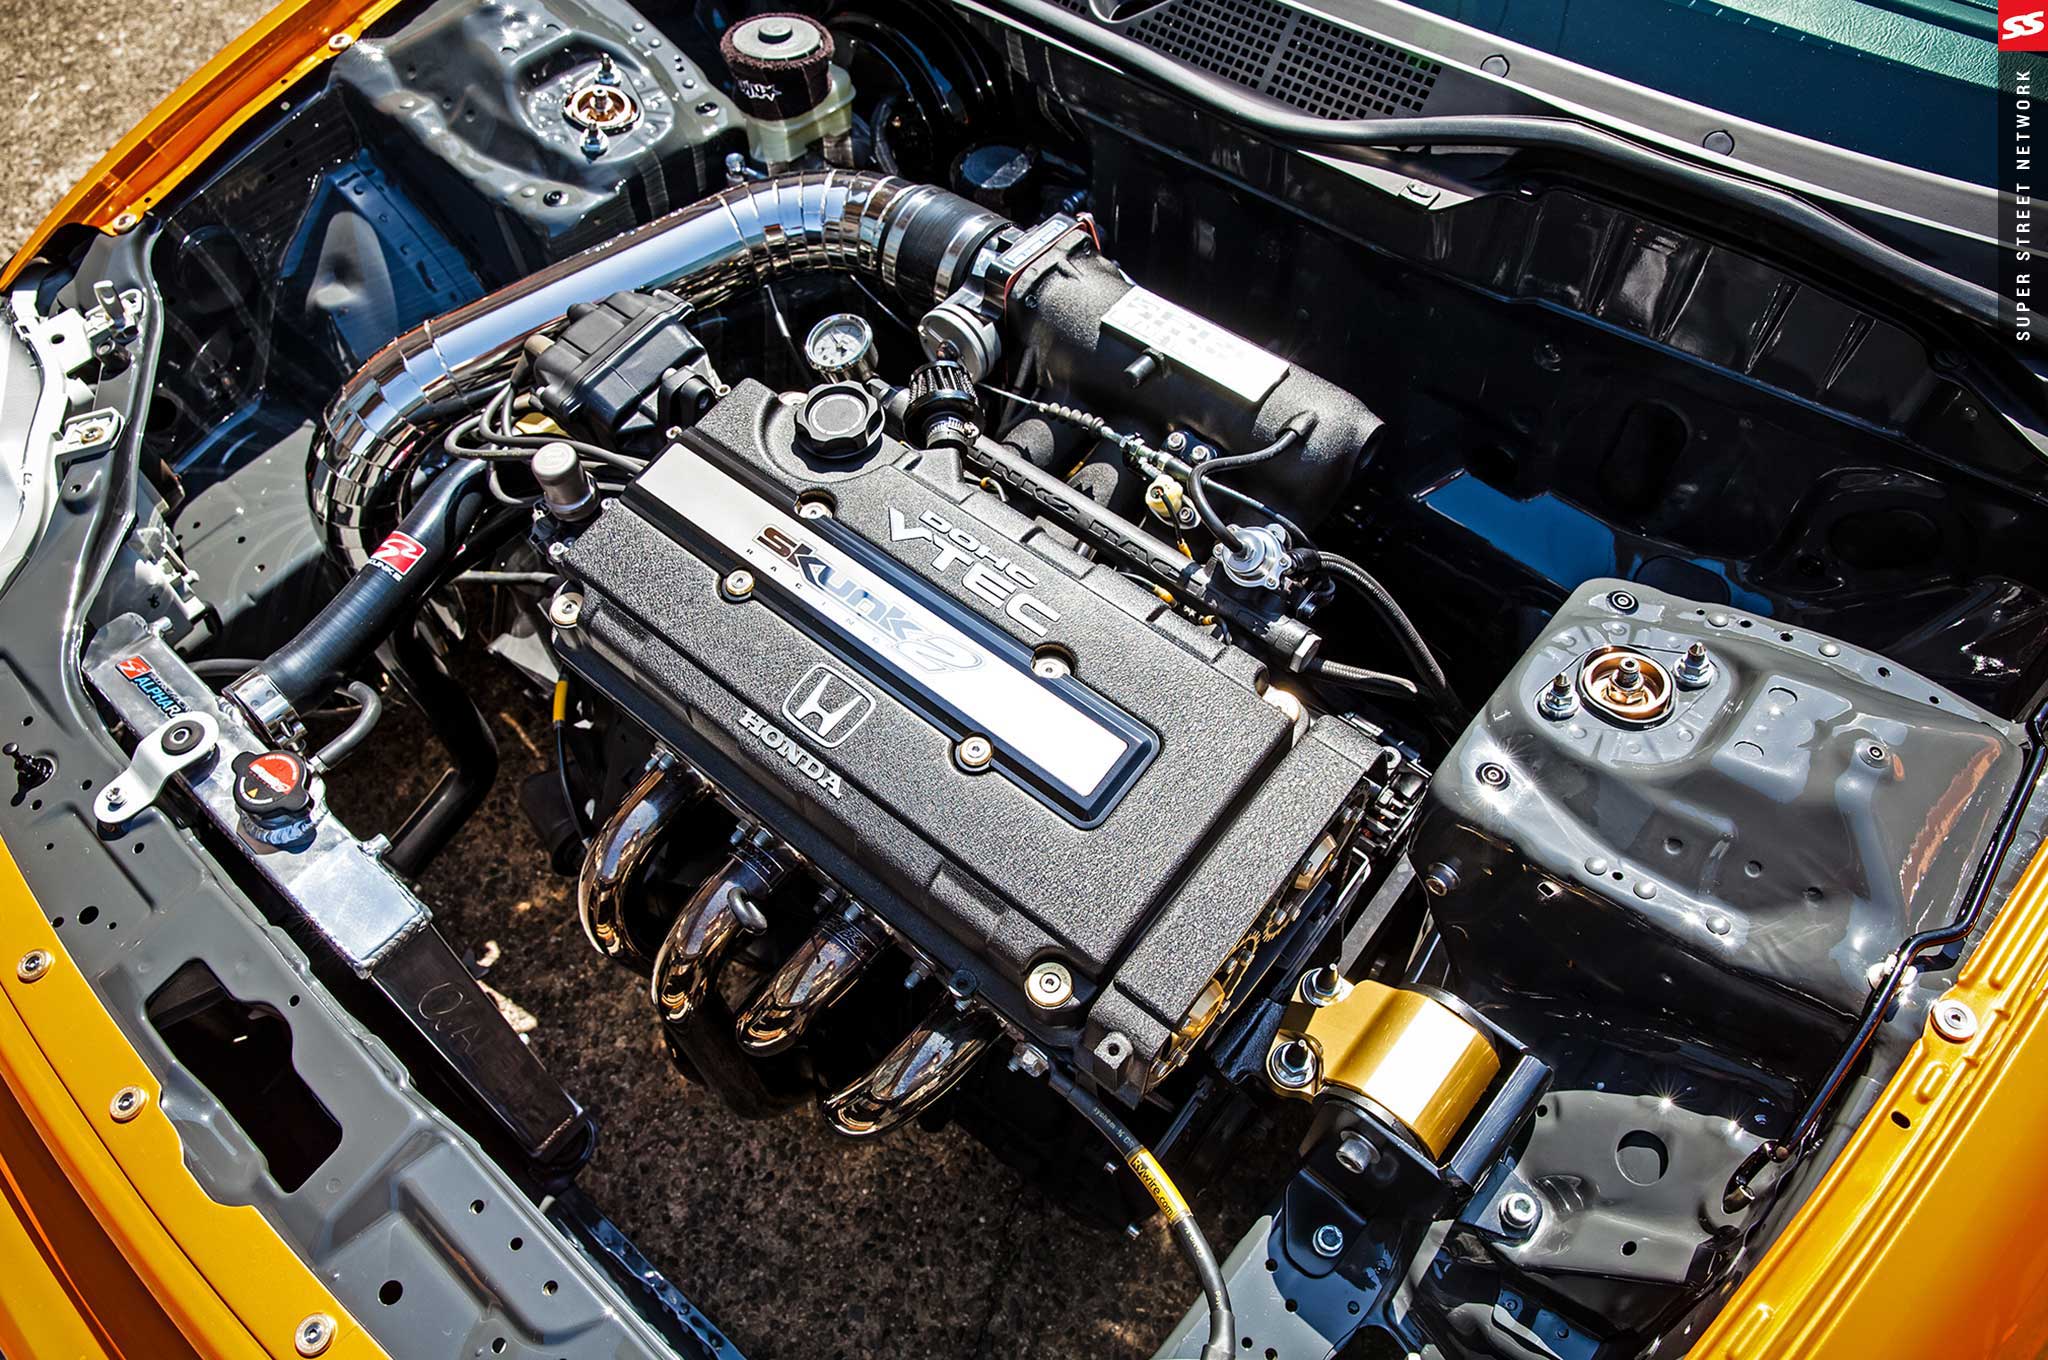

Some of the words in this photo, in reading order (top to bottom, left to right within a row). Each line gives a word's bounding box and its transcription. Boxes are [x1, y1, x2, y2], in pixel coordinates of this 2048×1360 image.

[888, 507, 1062, 638] VTEC
[919, 509, 1040, 590] DOHC
[134, 676, 182, 718] ALPHAR
[738, 708, 843, 799] HONDA
[1132, 1156, 1174, 1216] Rywire.com
